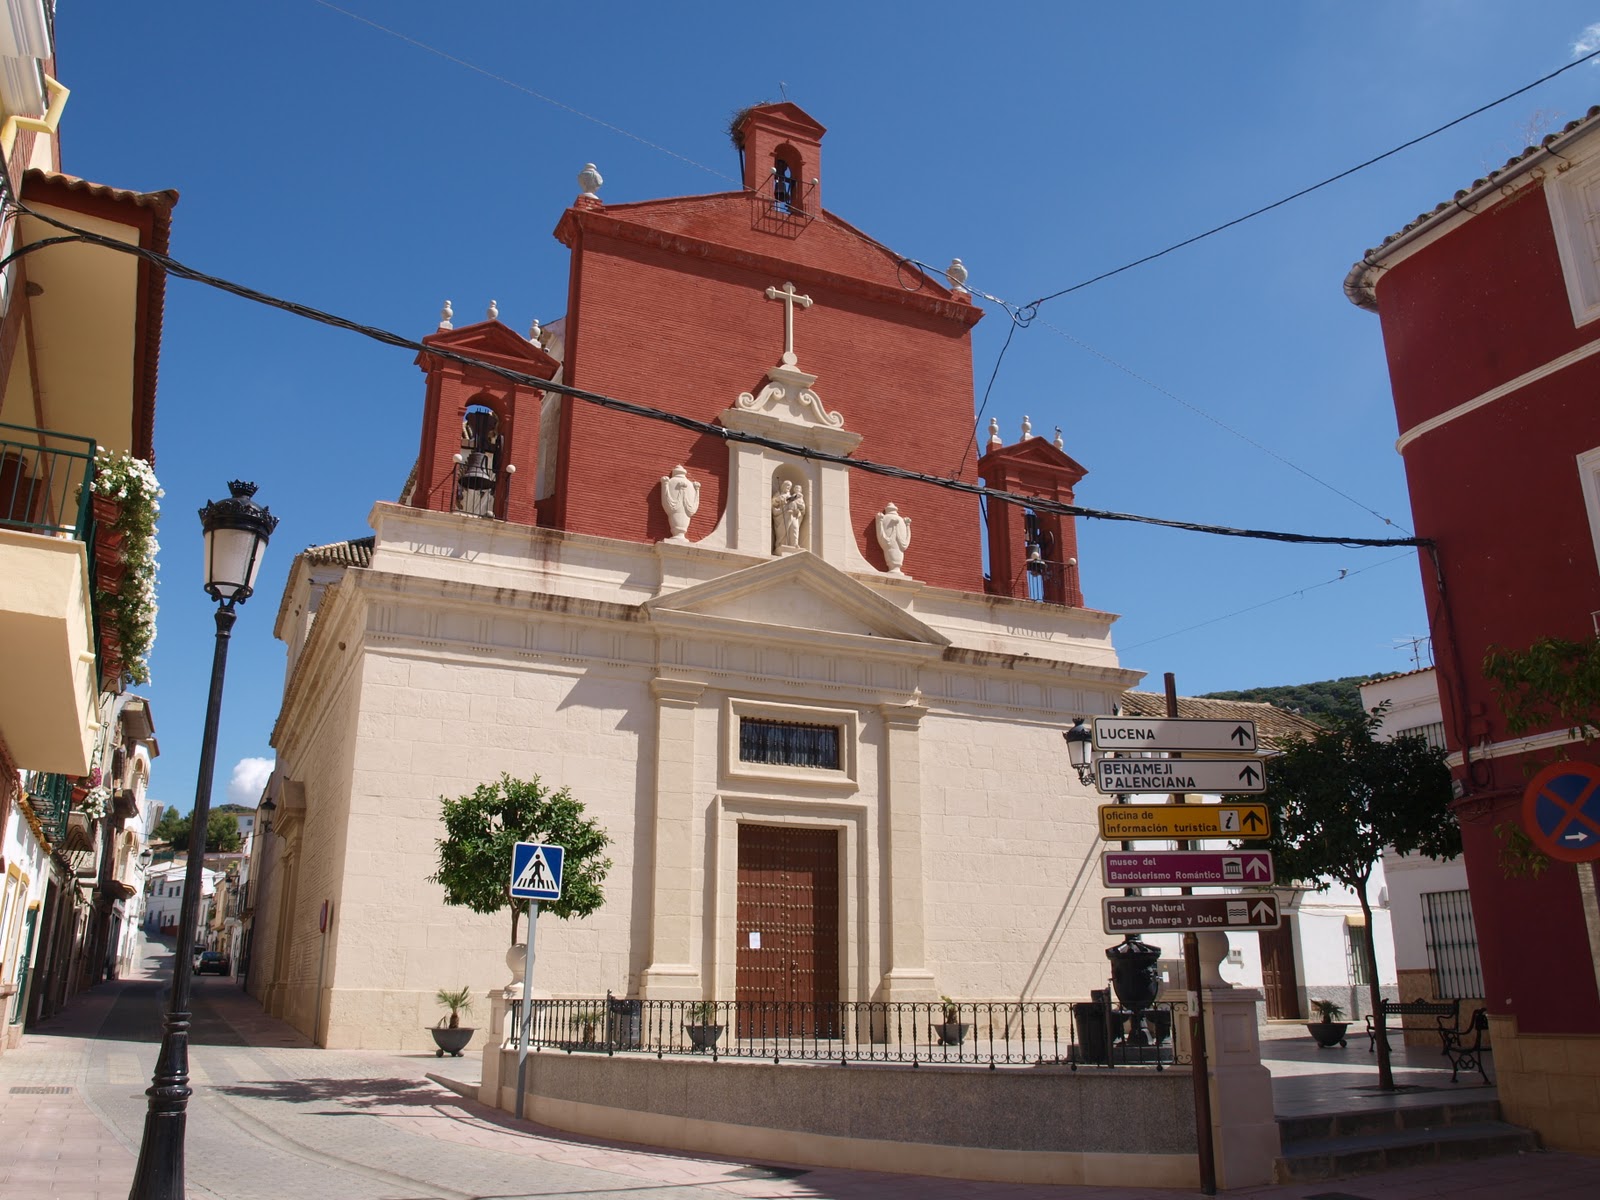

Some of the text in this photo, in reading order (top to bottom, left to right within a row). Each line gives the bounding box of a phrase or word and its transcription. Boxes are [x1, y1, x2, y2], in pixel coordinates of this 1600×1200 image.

[1100, 728, 1155, 740] LUCENA
[1104, 764, 1172, 774] BENAMEJI
[1105, 777, 1196, 788] PALENCIANA
[1106, 811, 1153, 820] oficina de
[1107, 824, 1168, 833] información
[1110, 858, 1156, 867] museo del
[1111, 871, 1221, 880] Bandolerismo Romántico
[1110, 904, 1185, 913] Reserva Natural
[1111, 915, 1223, 927] Laguna Amarga y Dulce
